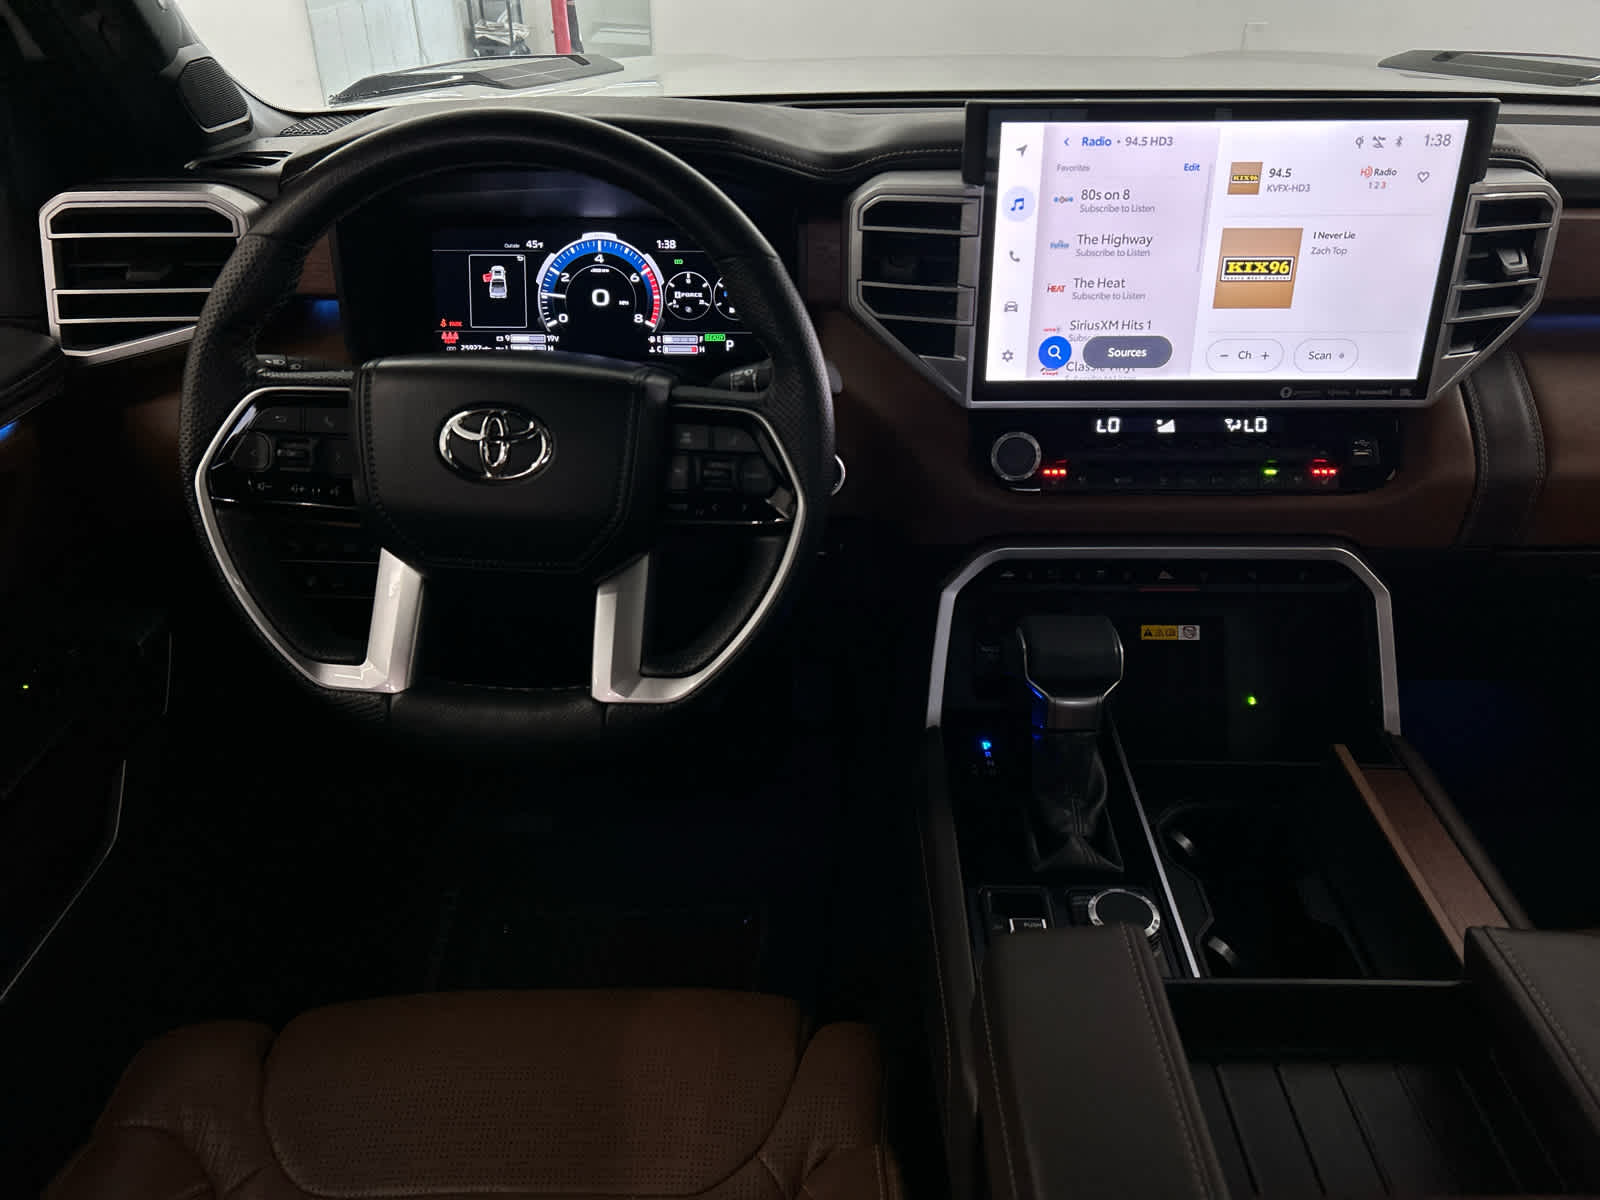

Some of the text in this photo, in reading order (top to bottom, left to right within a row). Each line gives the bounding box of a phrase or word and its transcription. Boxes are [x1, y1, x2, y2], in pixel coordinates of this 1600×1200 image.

[1081, 136, 1173, 147] Radio 94.5 HD3
[1424, 133, 1451, 147] 1:38
[1056, 163, 1091, 172] Favorites
[1183, 162, 1201, 172] Edit
[1373, 168, 1398, 176] Radio
[1269, 168, 1292, 178] 94.5
[1266, 183, 1311, 193] KVFX-HD3
[1081, 189, 1101, 200] 80s
[1104, 191, 1120, 200] on
[1122, 189, 1131, 200] 8
[1079, 204, 1155, 213] Subscribe to Listen
[1318, 231, 1342, 240] Never
[1343, 231, 1356, 240] Lie
[656, 240, 677, 249] 1:38
[1077, 234, 1098, 245] The
[1101, 234, 1153, 248] Highway
[1075, 248, 1150, 257] Subscribe to Listen
[1311, 246, 1348, 257] Zach Top
[594, 254, 604, 263] 4
[561, 273, 570, 282] 2
[630, 273, 640, 283] 6
[1073, 278, 1126, 288] The Heat
[1047, 284, 1066, 293] HEAT
[591, 288, 610, 307] 0
[1072, 292, 1146, 300] Subscribe to Listen
[558, 314, 569, 323] 0
[633, 313, 644, 323] 8
[1070, 320, 1119, 331] SiriusXM
[1121, 320, 1143, 331] Hits
[1146, 320, 1152, 331] 1
[726, 339, 734, 351] P
[1107, 347, 1148, 358] Sources
[1238, 350, 1252, 360] Ch
[1308, 351, 1332, 360] Scan
[1096, 416, 1120, 433] LO
[1244, 416, 1267, 433] LO
